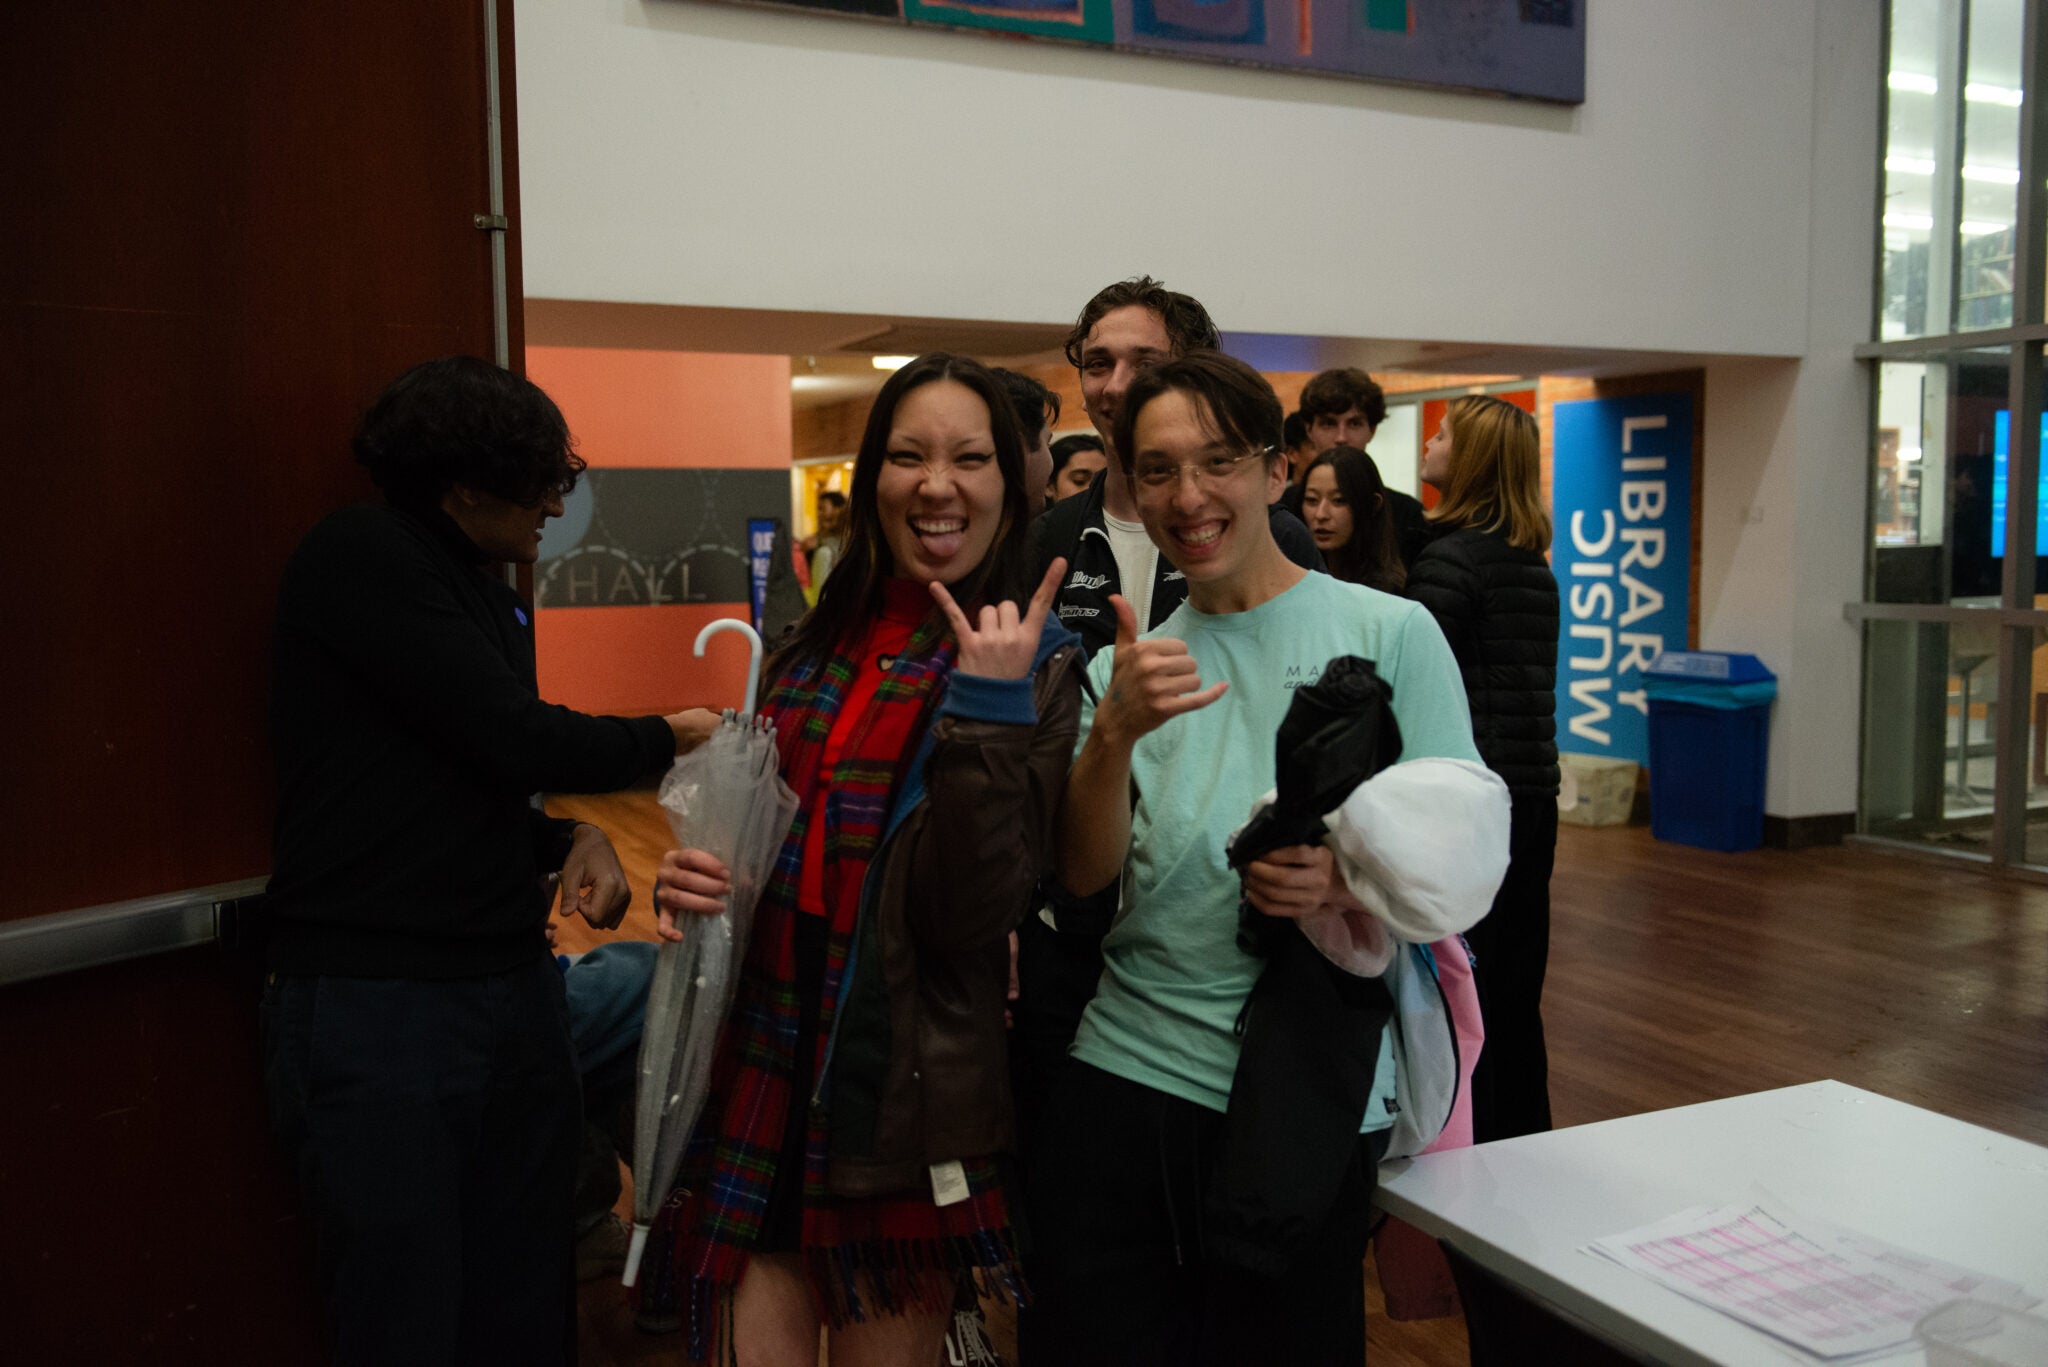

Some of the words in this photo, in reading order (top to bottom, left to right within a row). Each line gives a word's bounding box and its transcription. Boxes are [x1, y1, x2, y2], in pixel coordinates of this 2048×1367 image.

[568, 562, 708, 603] HALL
[1568, 508, 1616, 747] MUSIC
[1617, 415, 1668, 717] LIBRARY
